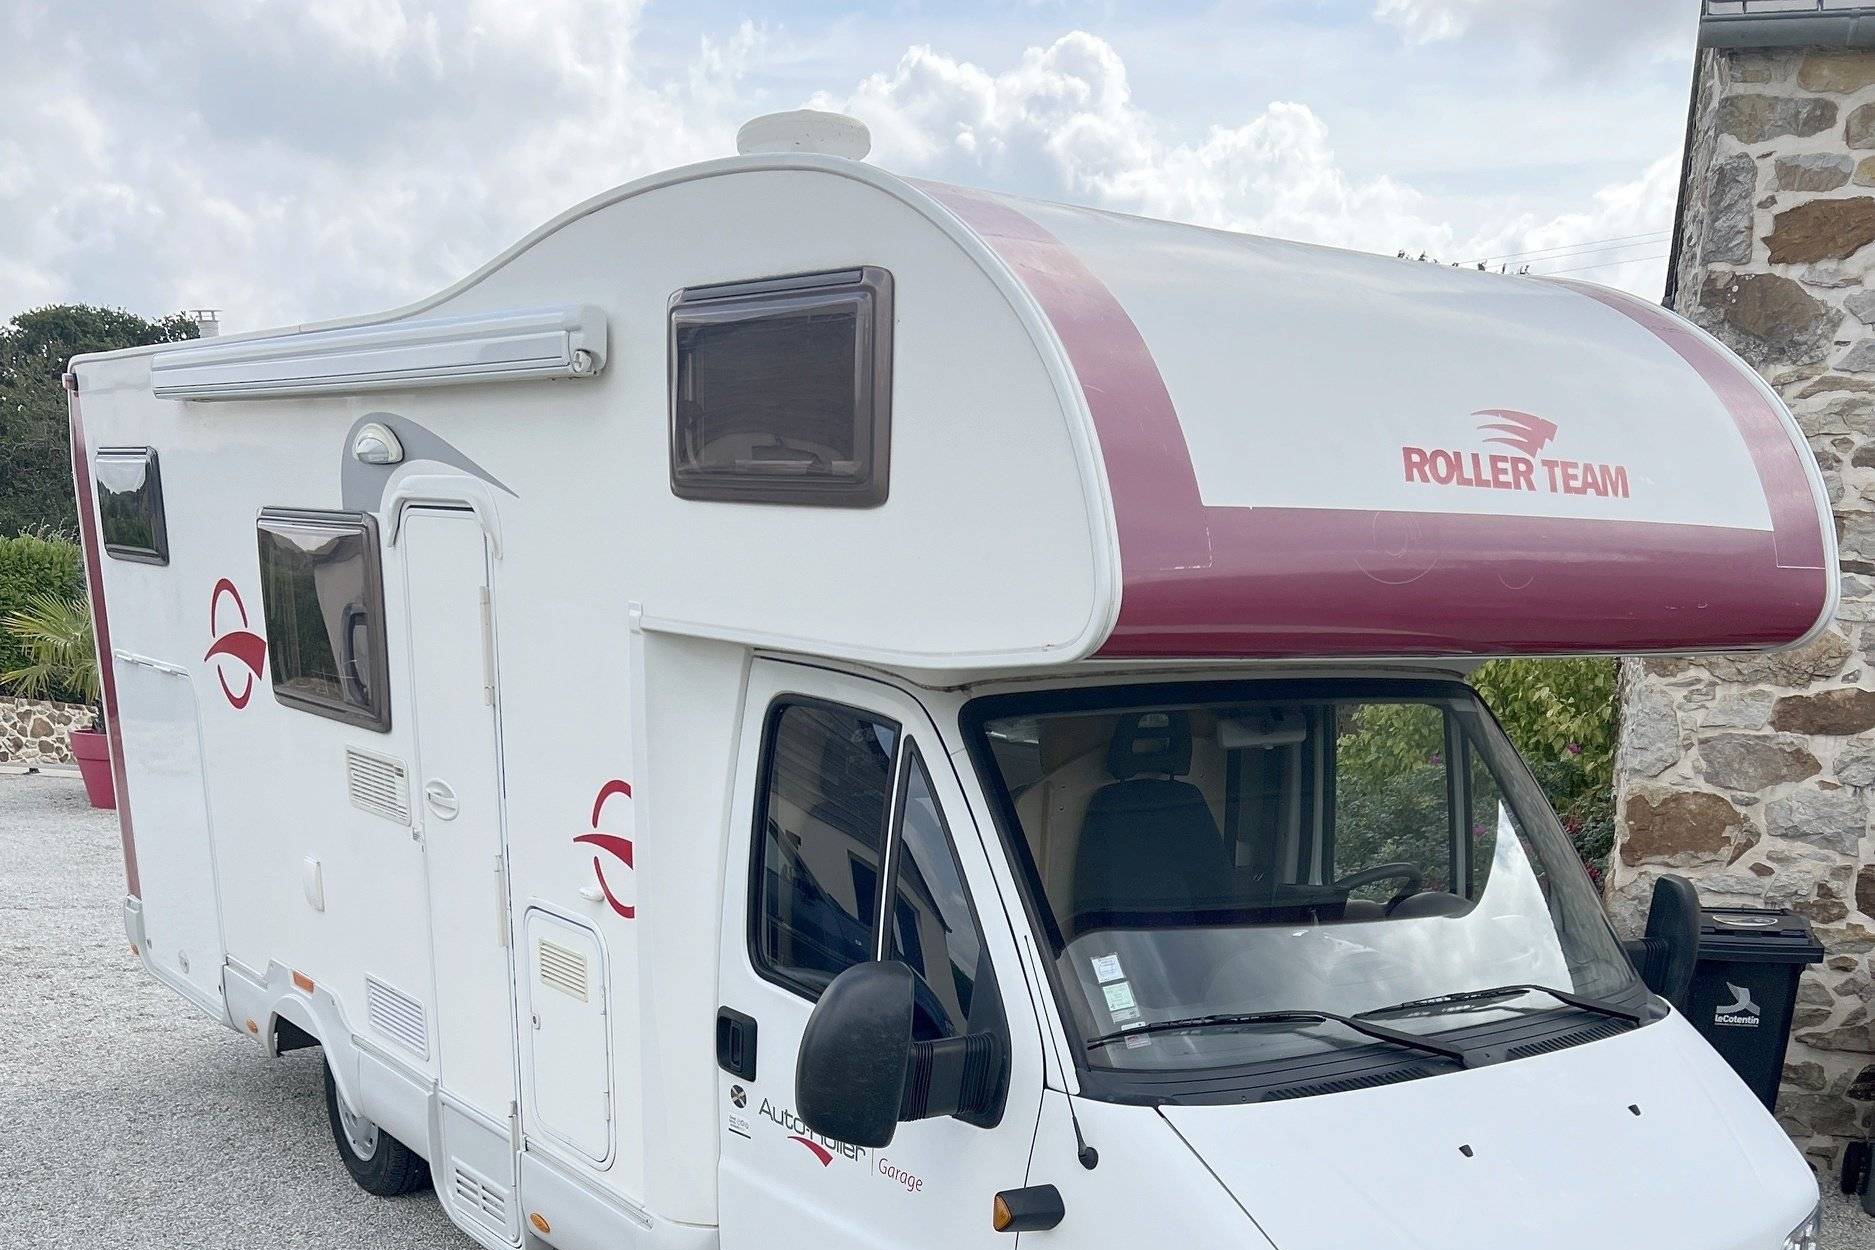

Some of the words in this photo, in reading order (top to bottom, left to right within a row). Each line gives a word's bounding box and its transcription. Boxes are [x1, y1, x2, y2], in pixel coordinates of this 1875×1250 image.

[1402, 446, 1537, 492] ROLLER
[1541, 458, 1631, 499] TEAM
[878, 1157, 924, 1193] Garage
